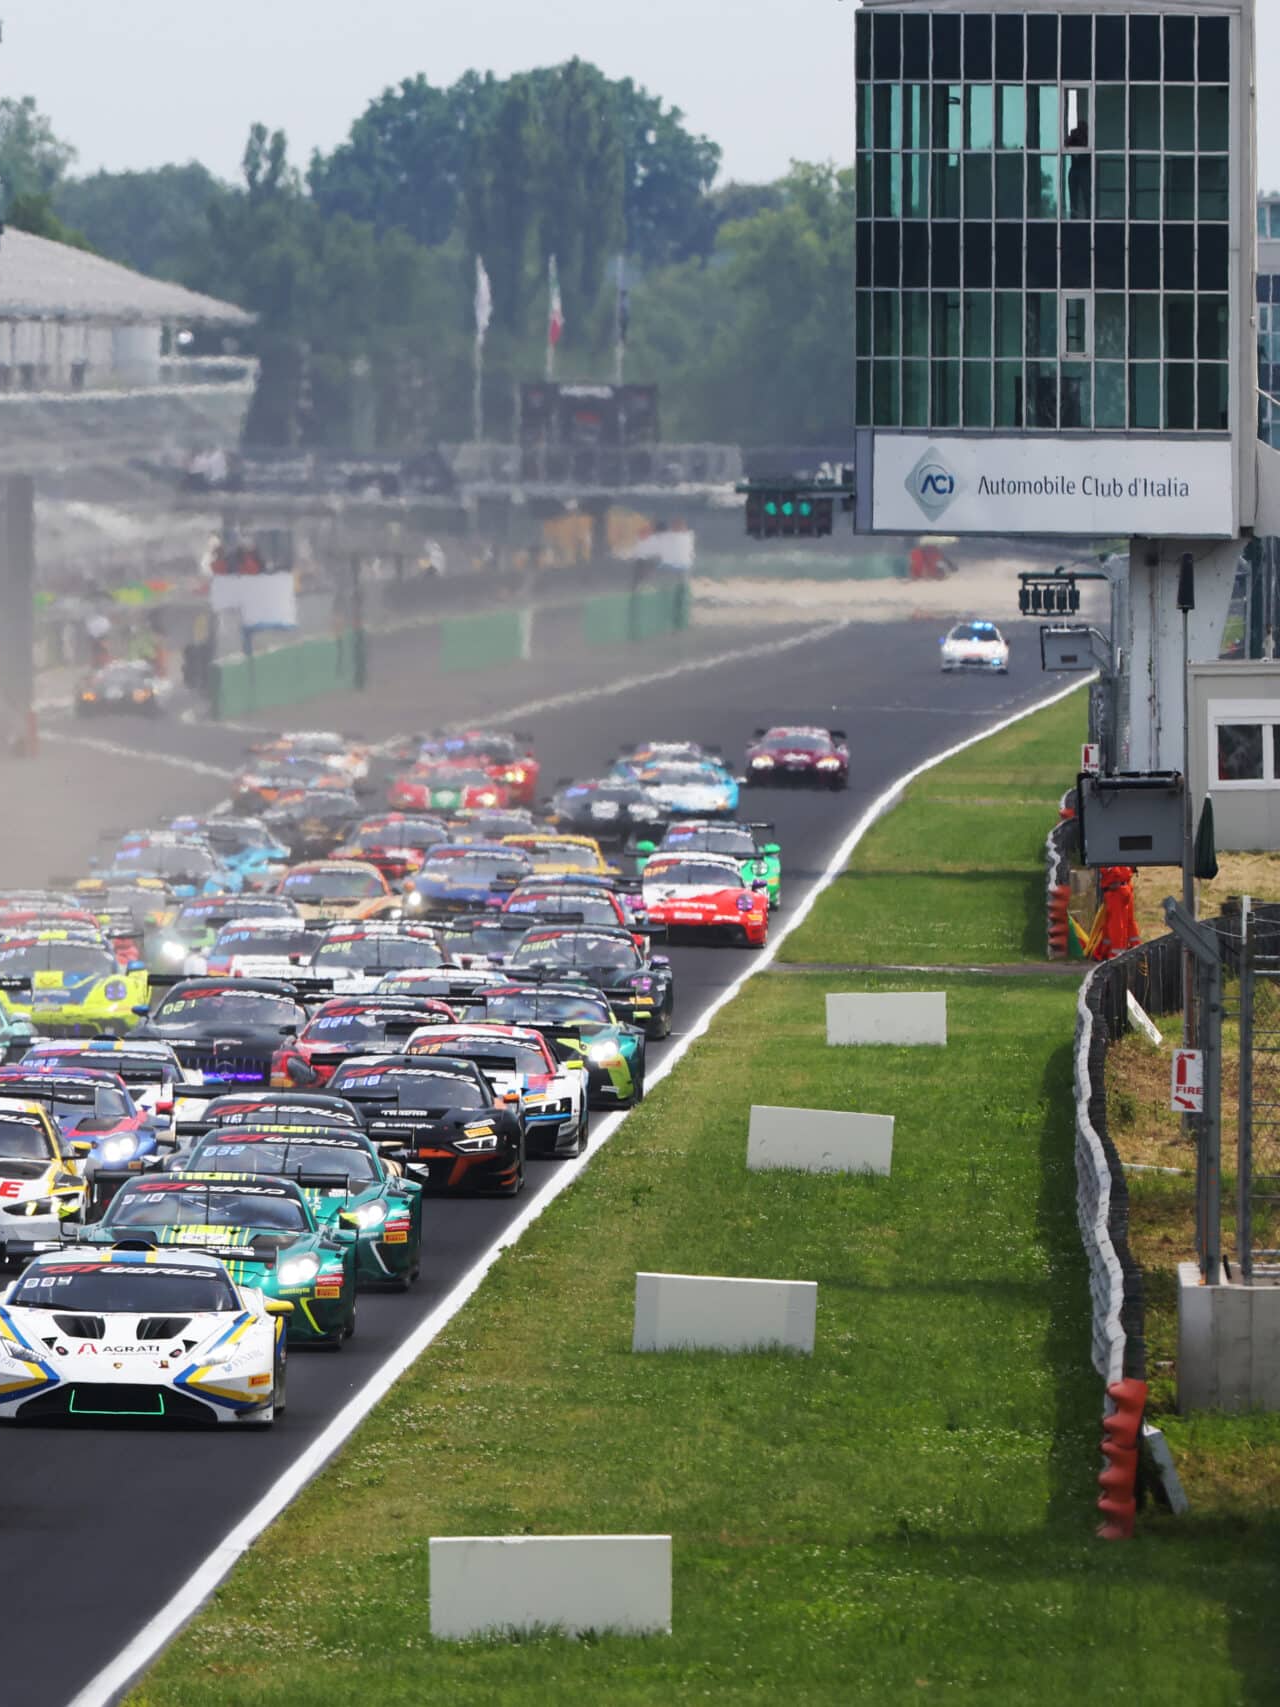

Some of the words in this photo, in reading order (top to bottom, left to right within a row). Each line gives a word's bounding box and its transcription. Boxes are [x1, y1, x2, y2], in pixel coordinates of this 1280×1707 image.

[977, 475, 1076, 496] Automobile
[1081, 475, 1123, 498] Club
[1128, 477, 1190, 498] d'Italia
[1176, 1085, 1206, 1096] FIRE
[39, 1263, 123, 1275] GT
[100, 1265, 217, 1278] WORLD
[103, 1345, 160, 1353] AGRATI
